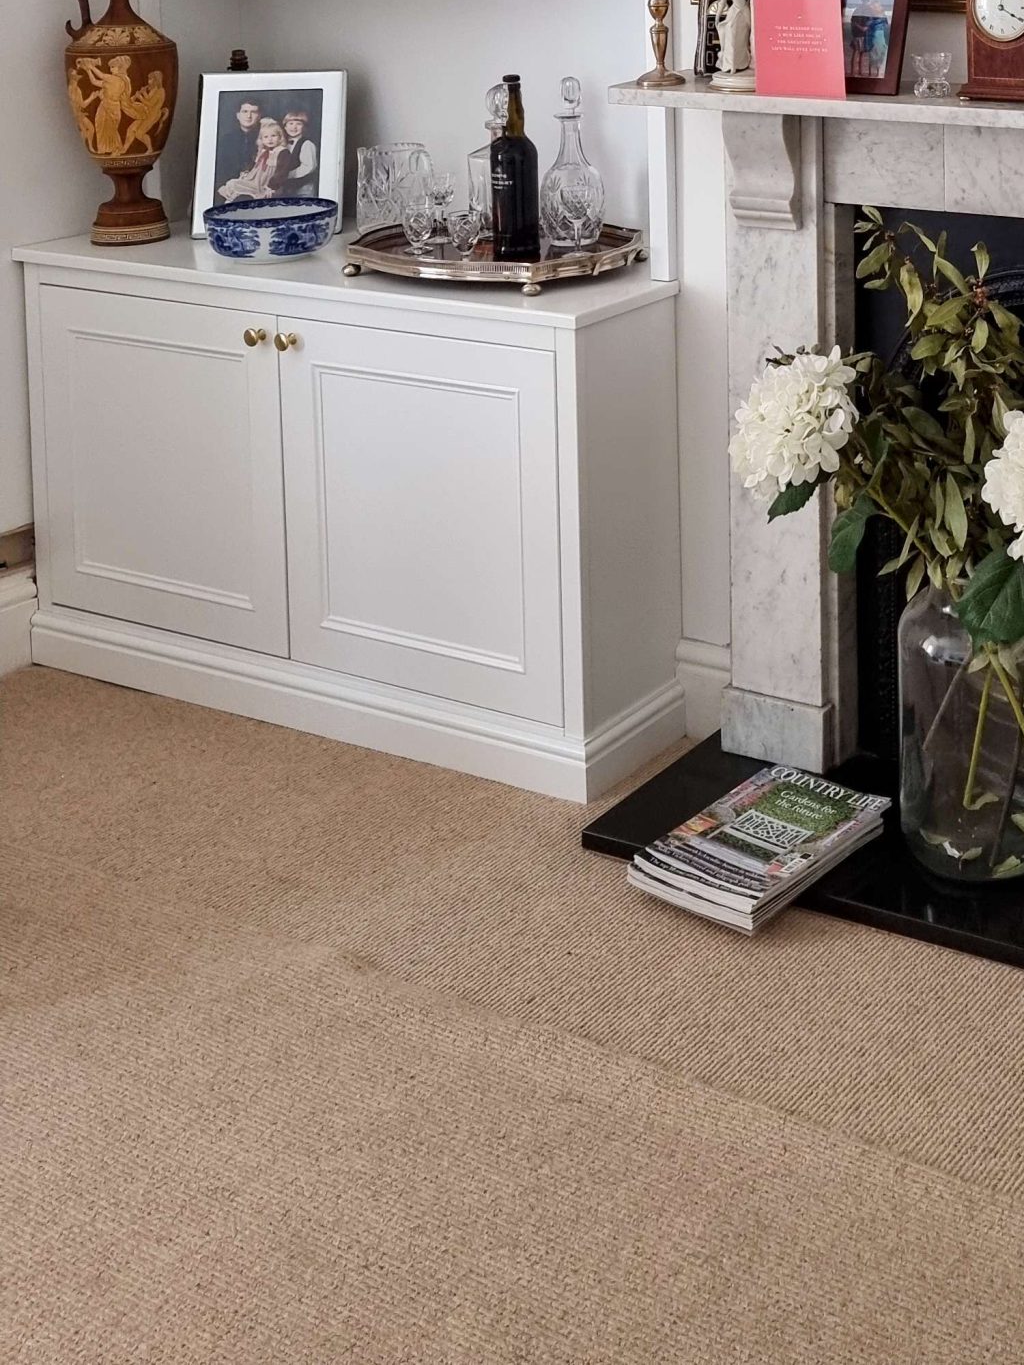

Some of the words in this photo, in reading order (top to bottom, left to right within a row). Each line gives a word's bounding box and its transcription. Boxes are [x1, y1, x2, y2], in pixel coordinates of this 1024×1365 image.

[770, 767, 850, 800] COUNTRY
[847, 793, 886, 811] LIFE
[775, 799, 791, 808] the
[792, 805, 822, 819] future
[780, 790, 821, 808] Gardens
[821, 805, 837, 814] for
